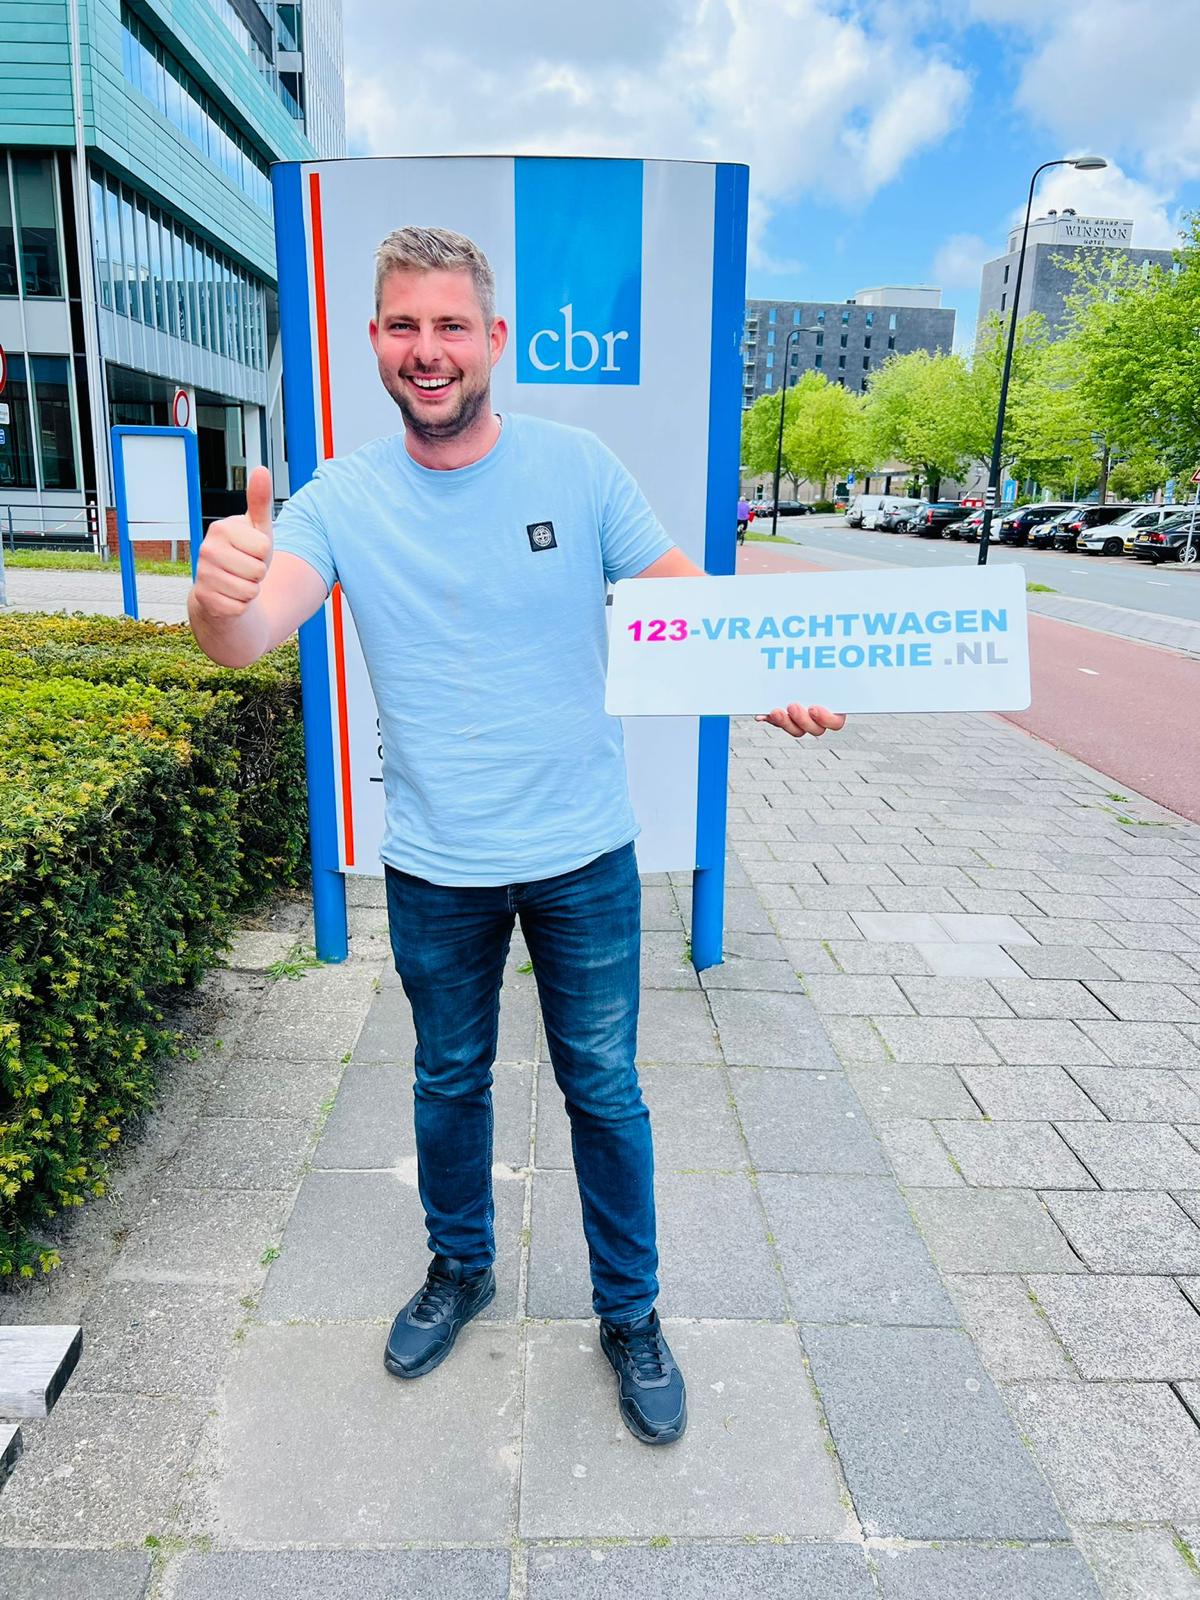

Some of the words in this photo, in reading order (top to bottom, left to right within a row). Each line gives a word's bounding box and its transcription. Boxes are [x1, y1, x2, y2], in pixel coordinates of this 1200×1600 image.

[1065, 225, 1127, 239] WINSTON
[528, 303, 629, 371] cbr
[626, 609, 1008, 642] 123-VRACHTWAGEN
[761, 642, 932, 669] THEORIE
[943, 641, 1008, 665] .NL
